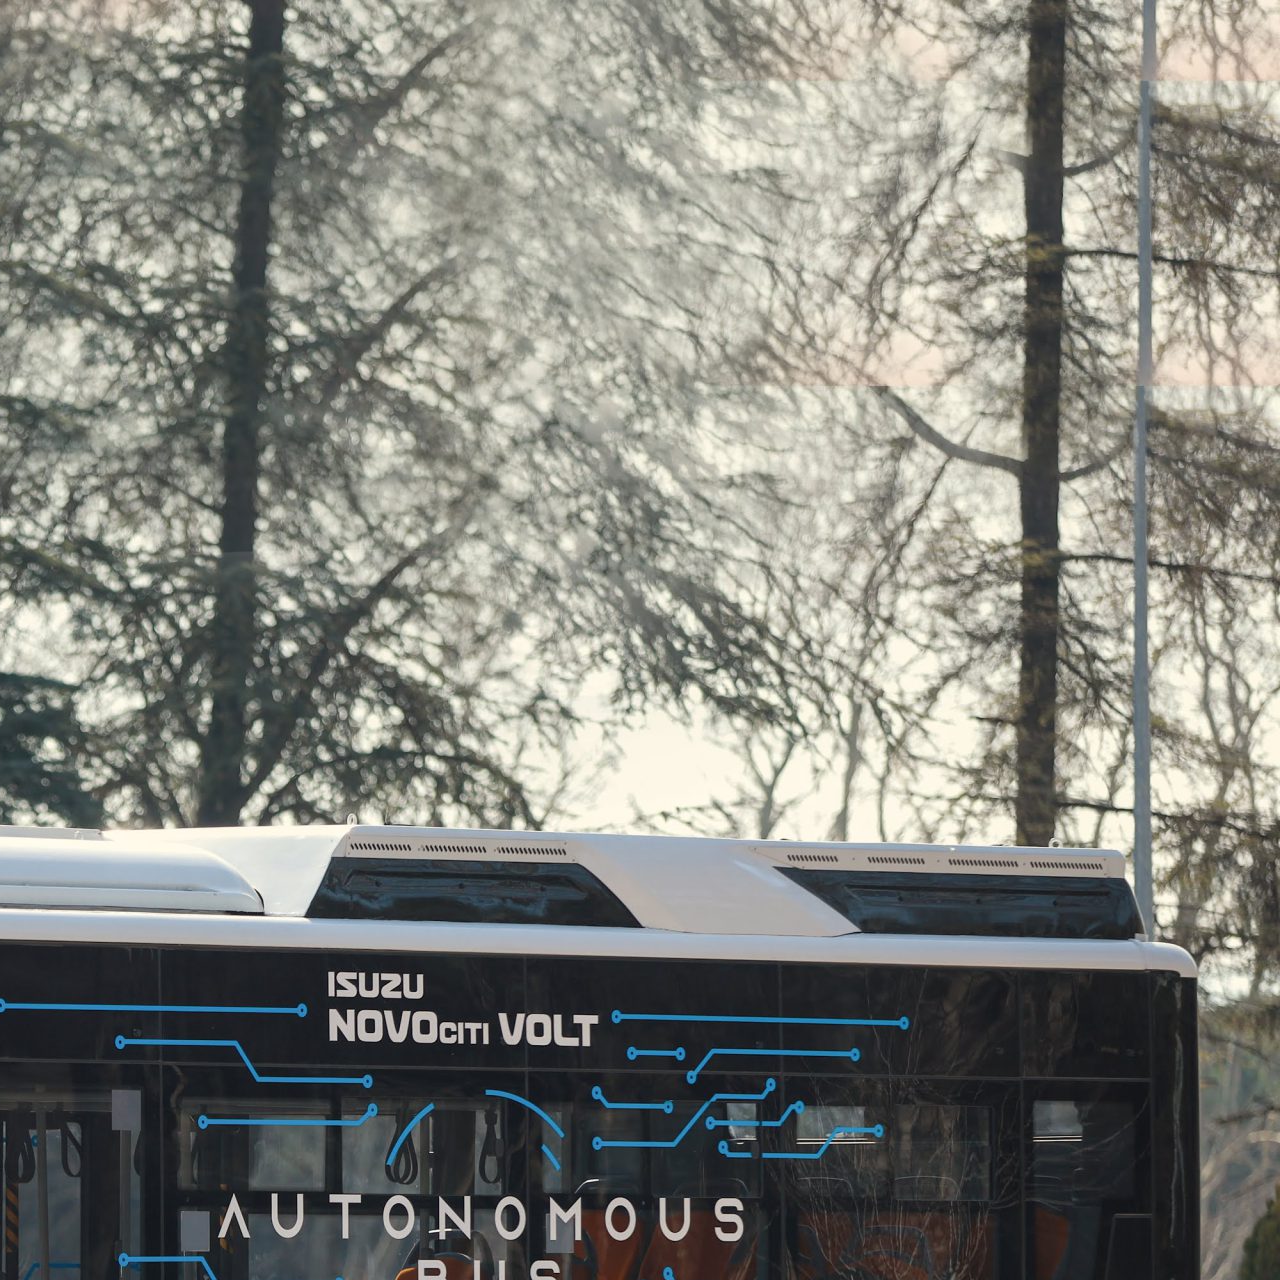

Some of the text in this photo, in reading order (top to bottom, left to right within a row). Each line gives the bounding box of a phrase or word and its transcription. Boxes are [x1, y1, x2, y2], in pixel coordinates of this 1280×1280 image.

[327, 971, 424, 1000] ISUZU
[498, 1012, 599, 1047] VOLT
[218, 1192, 745, 1242] AUTONOMOUS
